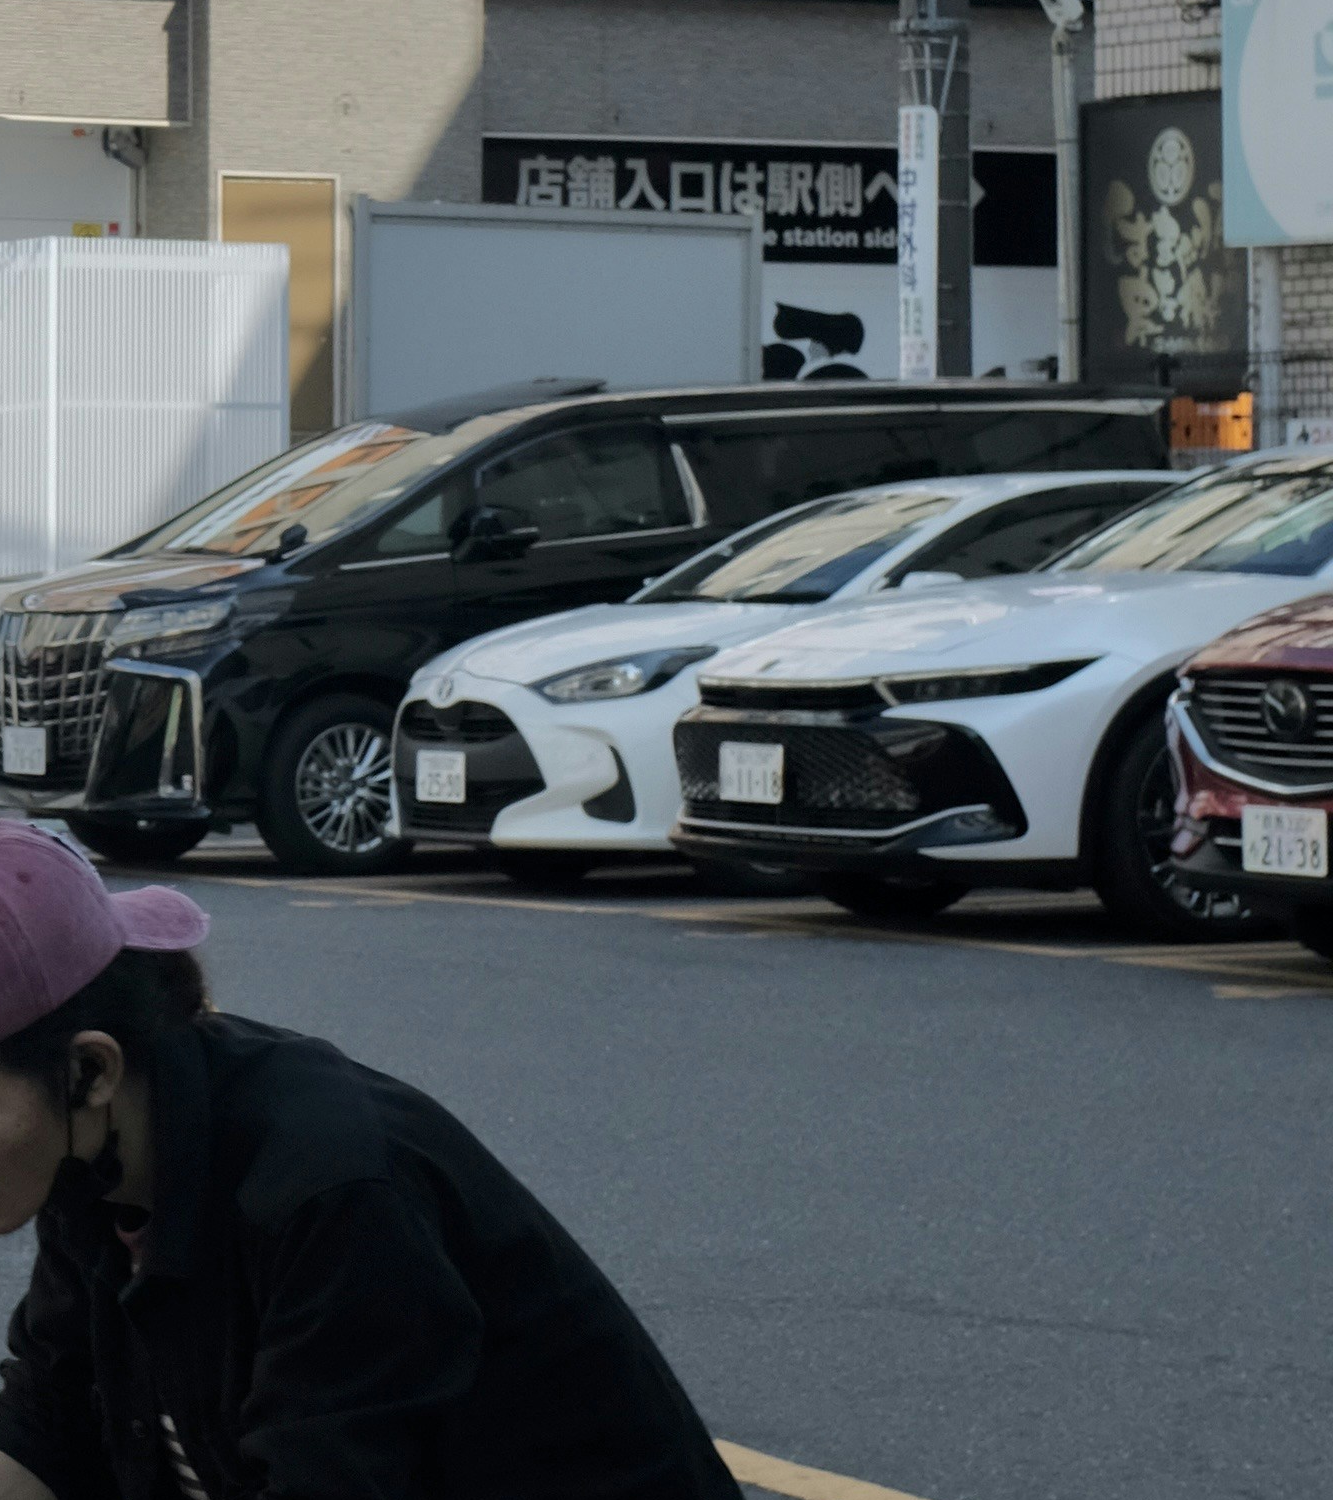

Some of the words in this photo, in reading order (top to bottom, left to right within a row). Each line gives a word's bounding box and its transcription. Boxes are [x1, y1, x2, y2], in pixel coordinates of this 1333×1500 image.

[515, 154, 898, 218] 店舗入口は駅側へ
[783, 226, 859, 249] station
[863, 226, 898, 249] sid
